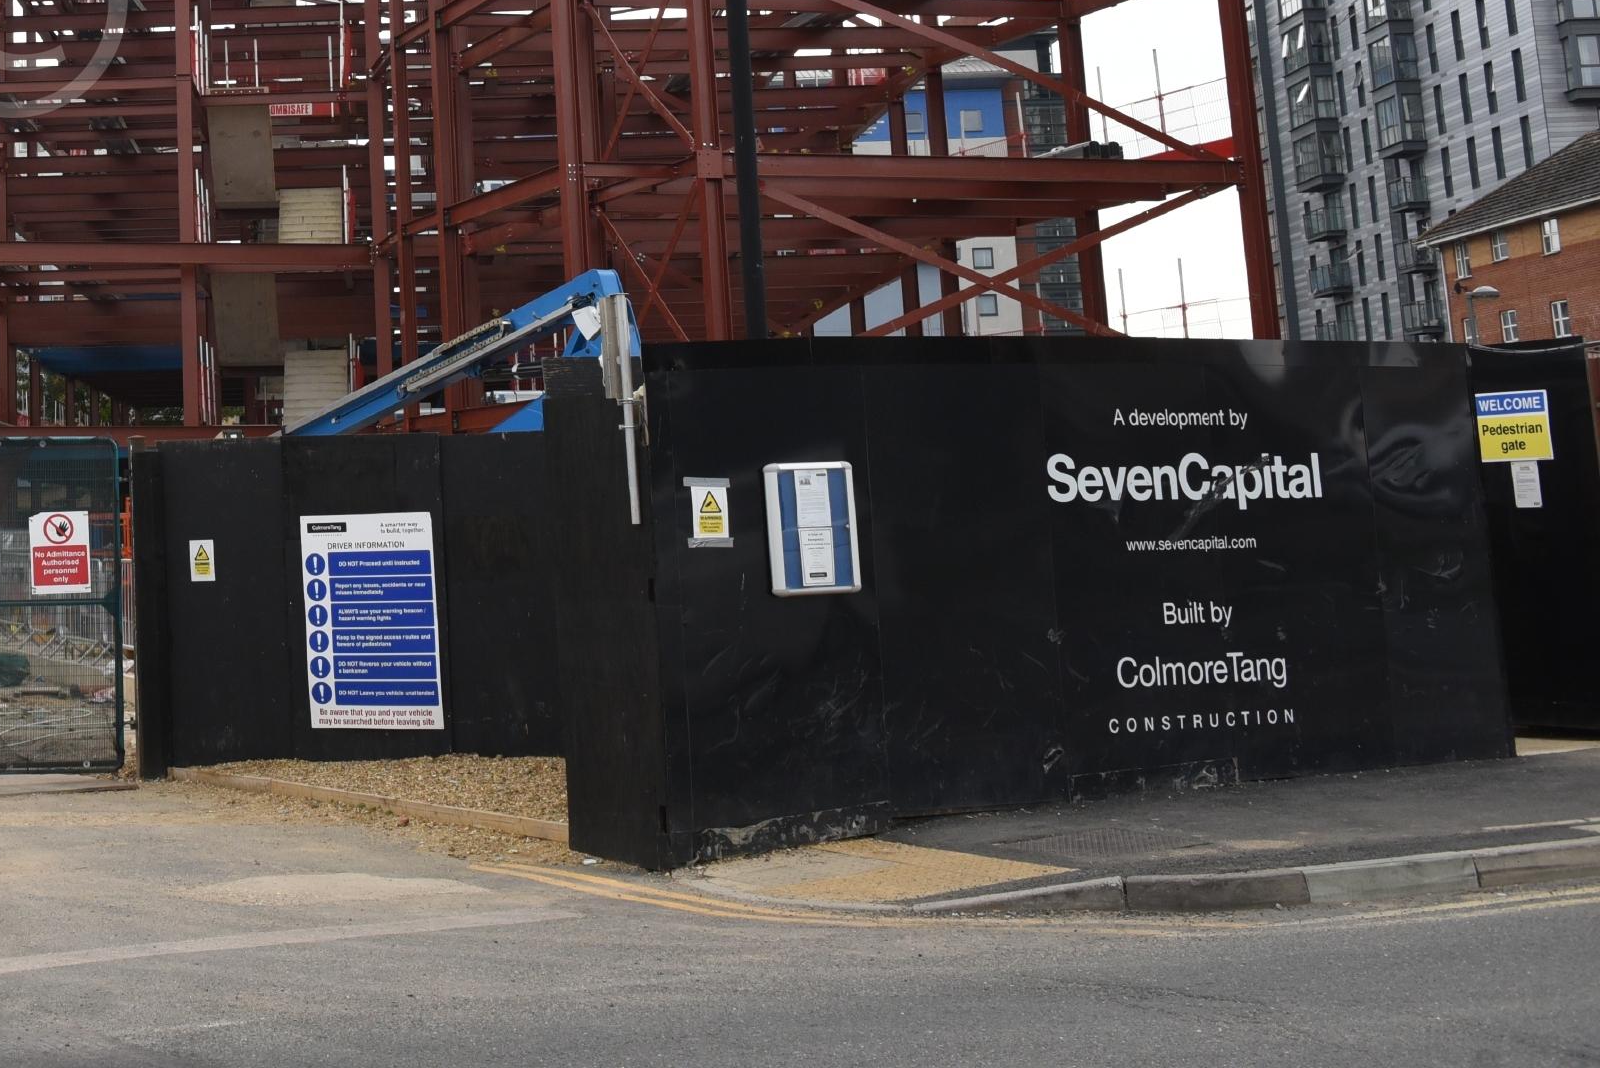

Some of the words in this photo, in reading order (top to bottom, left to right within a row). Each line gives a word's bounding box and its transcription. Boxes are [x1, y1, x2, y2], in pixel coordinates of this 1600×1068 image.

[270, 104, 309, 114] OMBISAFE
[1478, 396, 1542, 412] WELCOME
[1113, 409, 1125, 427] A
[1129, 408, 1225, 430] development
[1229, 408, 1248, 430] by
[1482, 422, 1542, 436] Pedestrian
[1501, 440, 1526, 454] gate
[1046, 452, 1323, 510] SevenCapital
[328, 542, 352, 550] DRIVER
[354, 541, 405, 549] INFORMATION
[1126, 535, 1257, 552] www.sevencapital.com
[1162, 601, 1206, 625] Built
[1210, 601, 1232, 628] by
[1116, 652, 1288, 688] ColmoreTang
[350, 708, 364, 716] that
[364, 710, 377, 718] you
[392, 710, 408, 718] your
[1108, 708, 1295, 734] CONSTRUCTION
[319, 718, 332, 726] may
[373, 718, 394, 726] before
[396, 718, 420, 726] leaving
[422, 718, 435, 726] site
